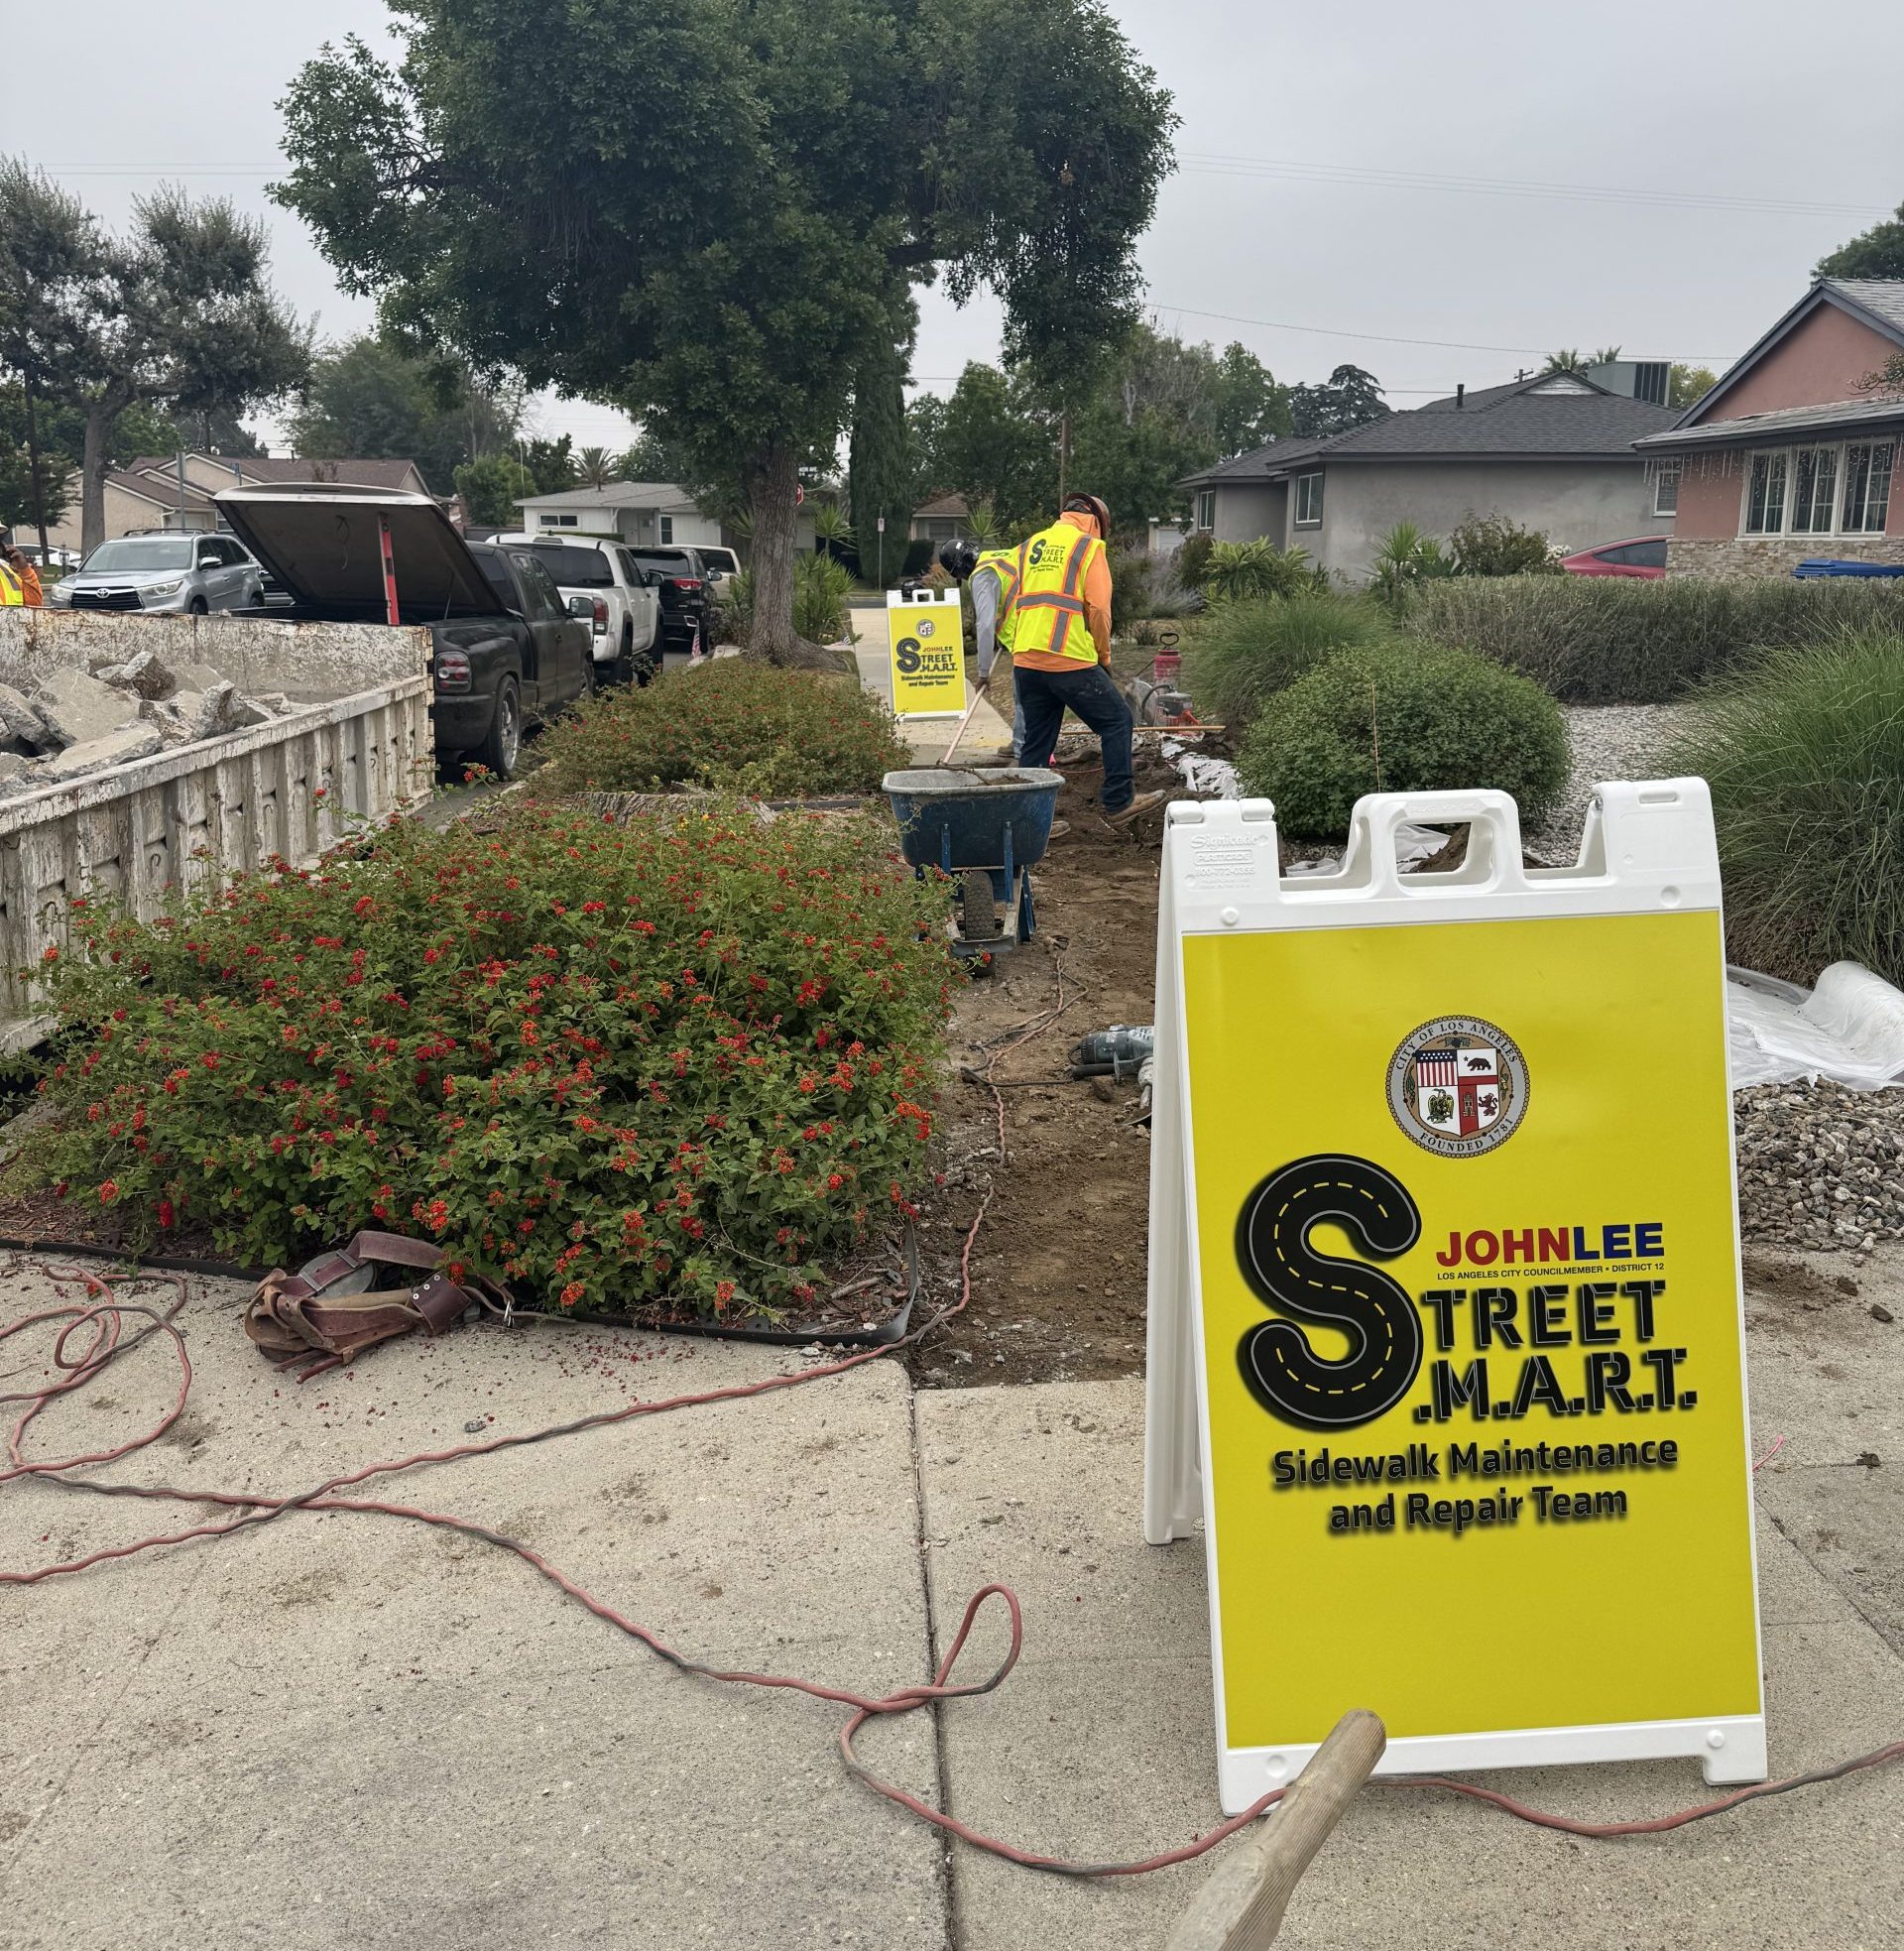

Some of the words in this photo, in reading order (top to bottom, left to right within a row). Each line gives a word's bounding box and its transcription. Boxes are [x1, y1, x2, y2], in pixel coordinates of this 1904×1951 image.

[1396, 1043, 1418, 1070] CITY
[1419, 1028, 1435, 1041] OF
[1440, 1021, 1465, 1032] LOS
[1470, 1023, 1518, 1063] ANGELES
[1419, 1133, 1485, 1153] FOUNDED
[1488, 1118, 1514, 1142] 1781
[1437, 1271, 1456, 1280] LOS
[1457, 1269, 1499, 1280] ANGELES
[1500, 1268, 1521, 1279] CITY
[1523, 1265, 1605, 1278] COUNCILMEMBER
[1611, 1262, 1652, 1273] DISTRICT
[1655, 1262, 1665, 1272] 12
[1273, 1443, 1440, 1484] Sidewalk
[1450, 1438, 1678, 1476] Maintenance
[1330, 1493, 1395, 1530] and
[1407, 1487, 1524, 1532] Repair
[1531, 1485, 1627, 1520] Team
